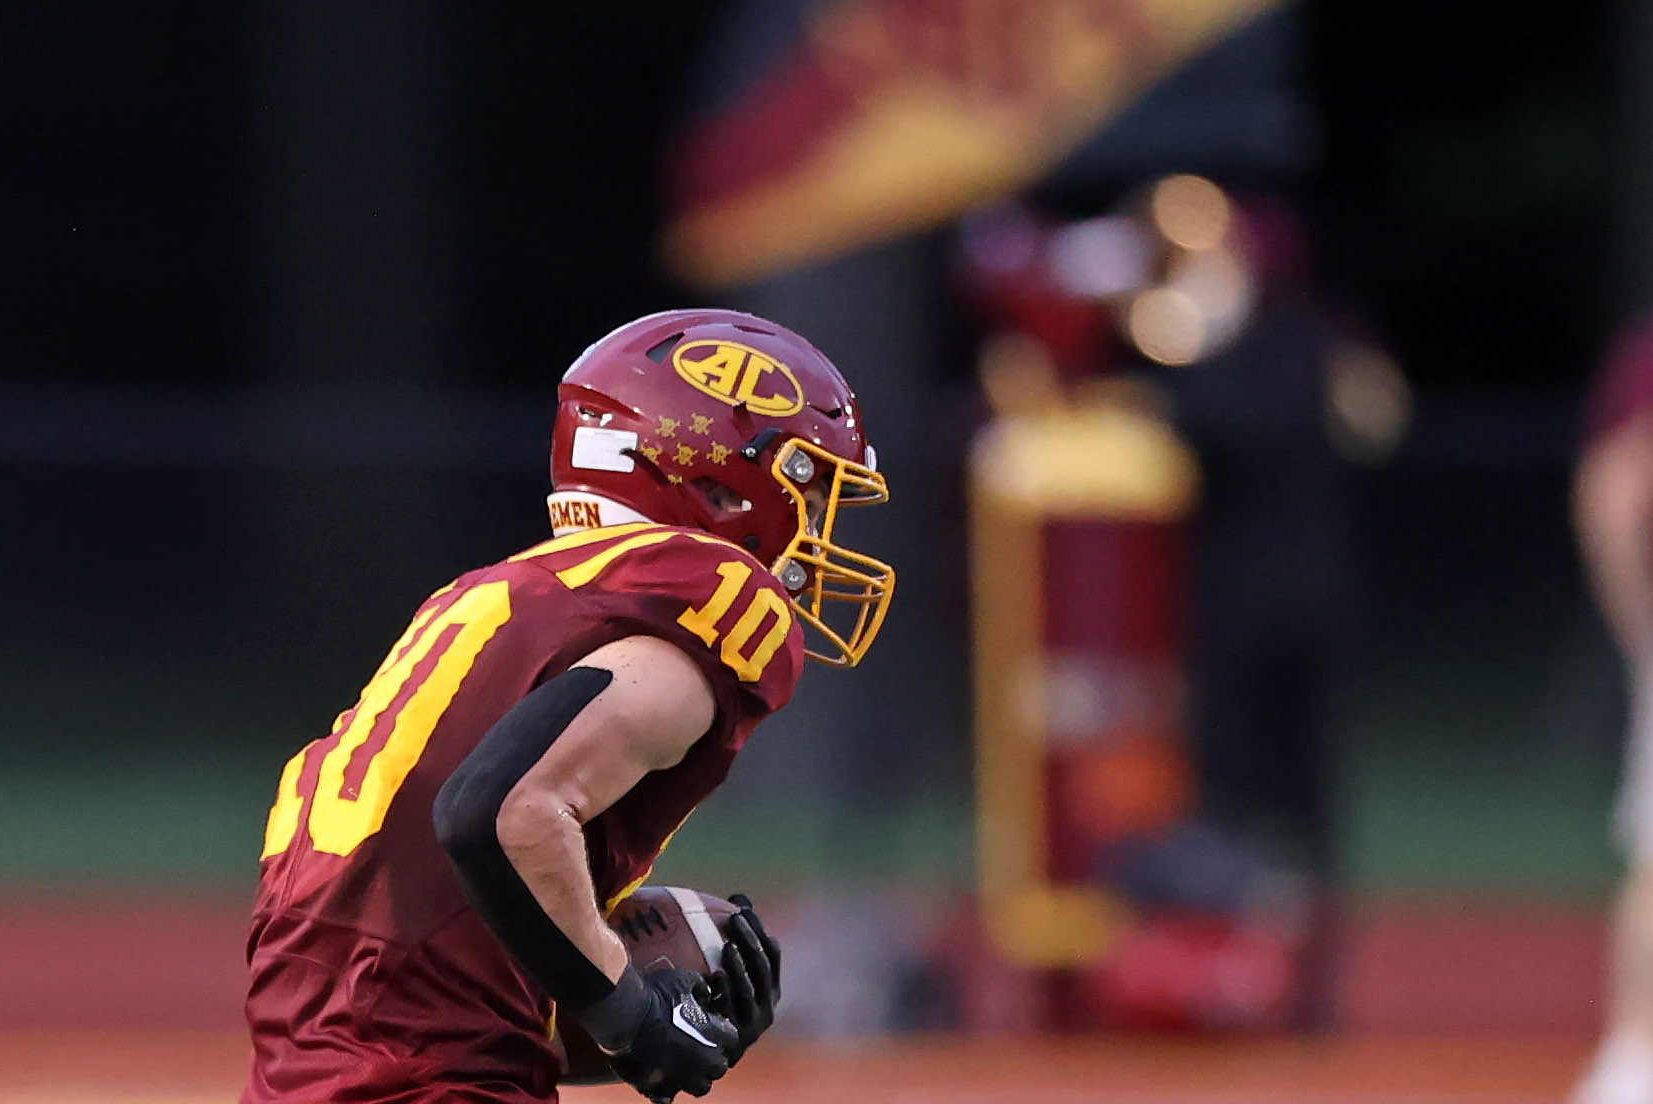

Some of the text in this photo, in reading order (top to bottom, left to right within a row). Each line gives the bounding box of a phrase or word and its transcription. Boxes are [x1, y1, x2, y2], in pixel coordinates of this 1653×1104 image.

[680, 345, 796, 414] AC
[677, 561, 792, 682] 10
[259, 579, 512, 862] 10
